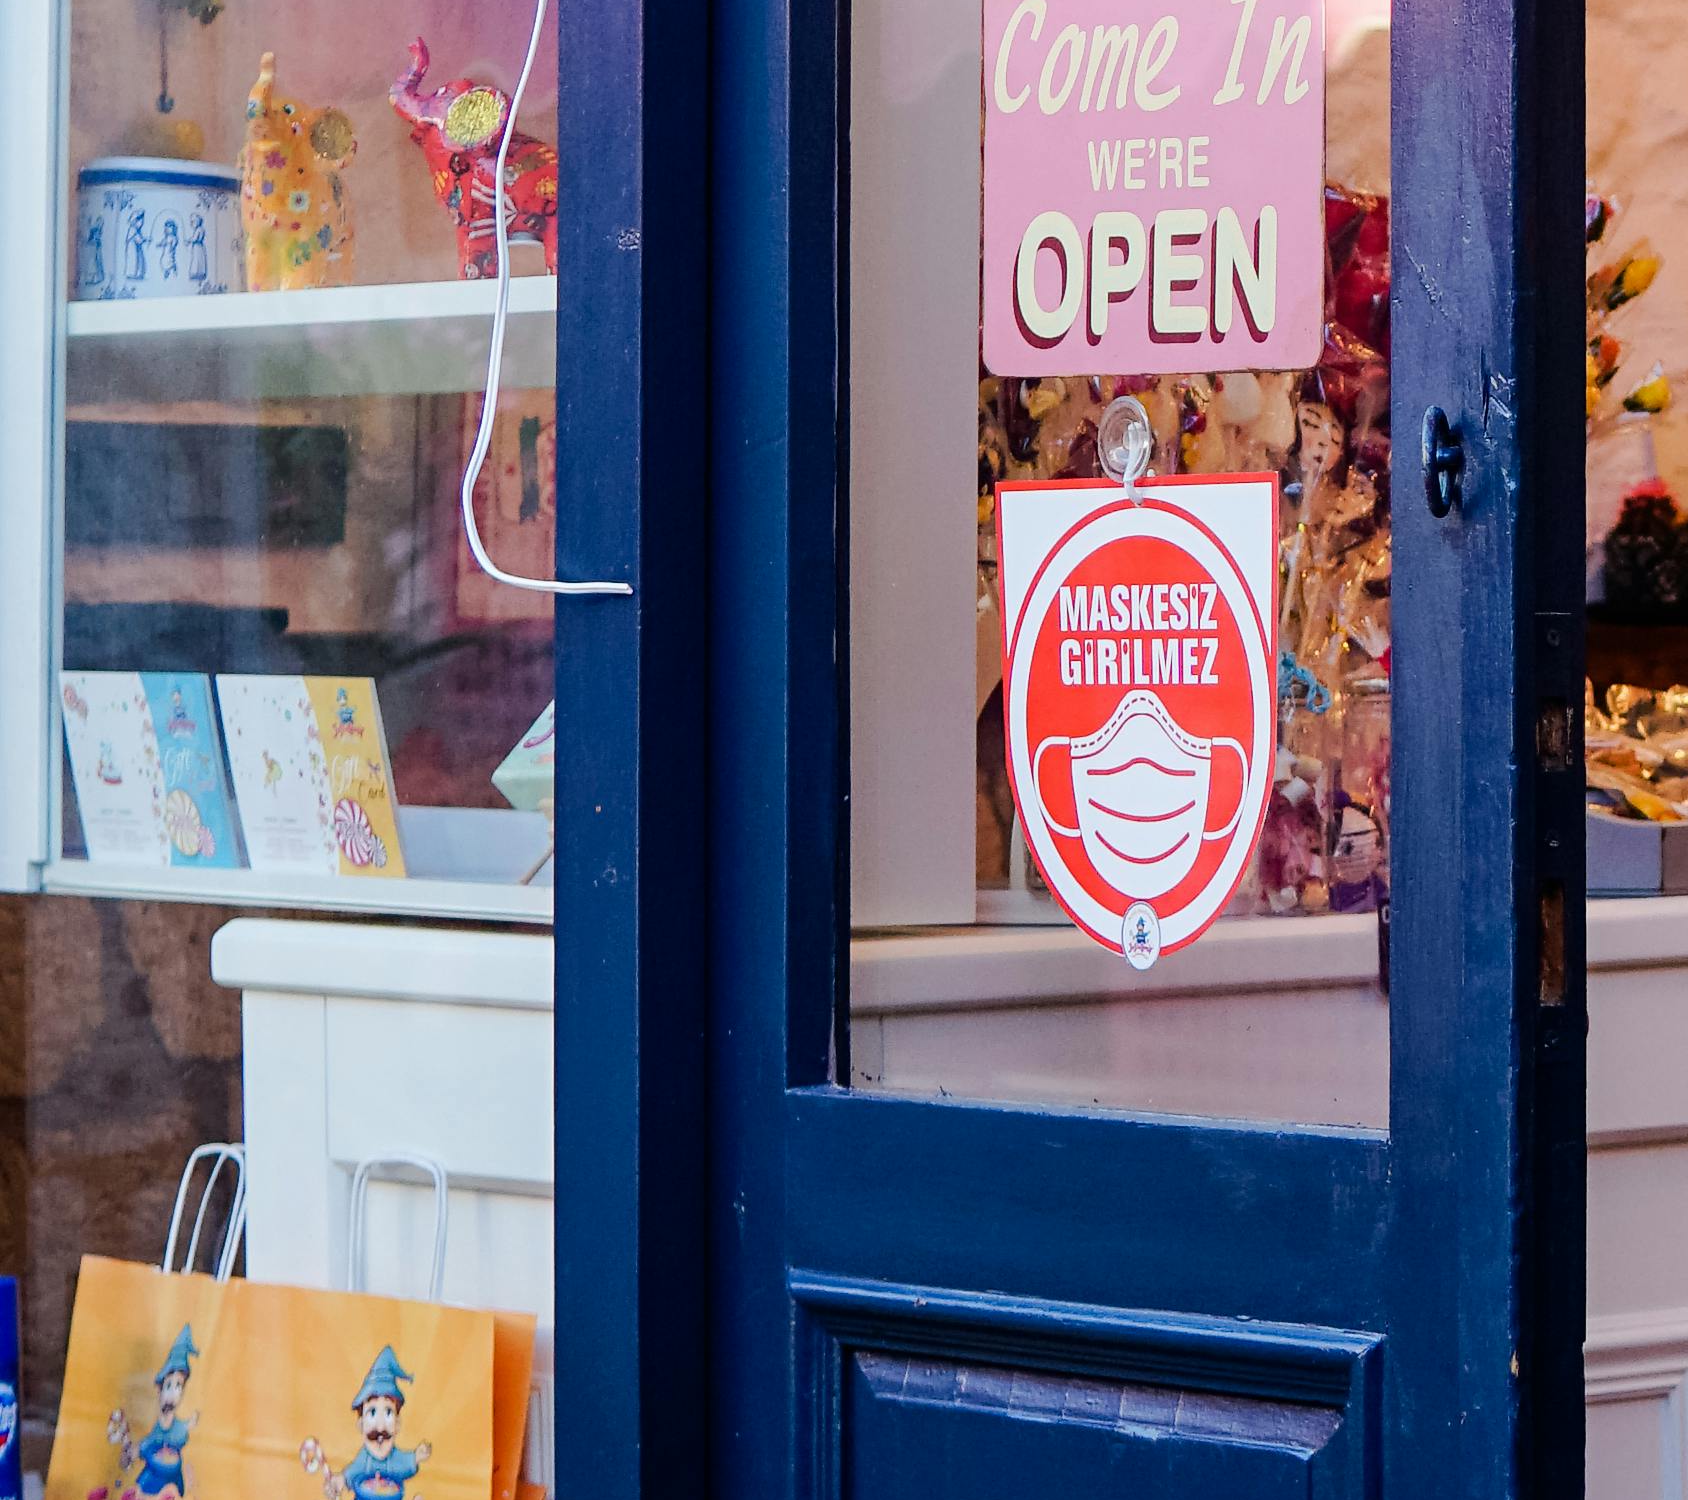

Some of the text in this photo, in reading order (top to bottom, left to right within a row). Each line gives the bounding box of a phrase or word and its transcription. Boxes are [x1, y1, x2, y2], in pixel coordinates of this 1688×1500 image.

[1087, 136, 1210, 191] WE'RE
[1013, 205, 1278, 350] OPEN
[1059, 583, 1218, 632] MASKESİZ
[1060, 637, 1219, 686] GİRİLMEZ
